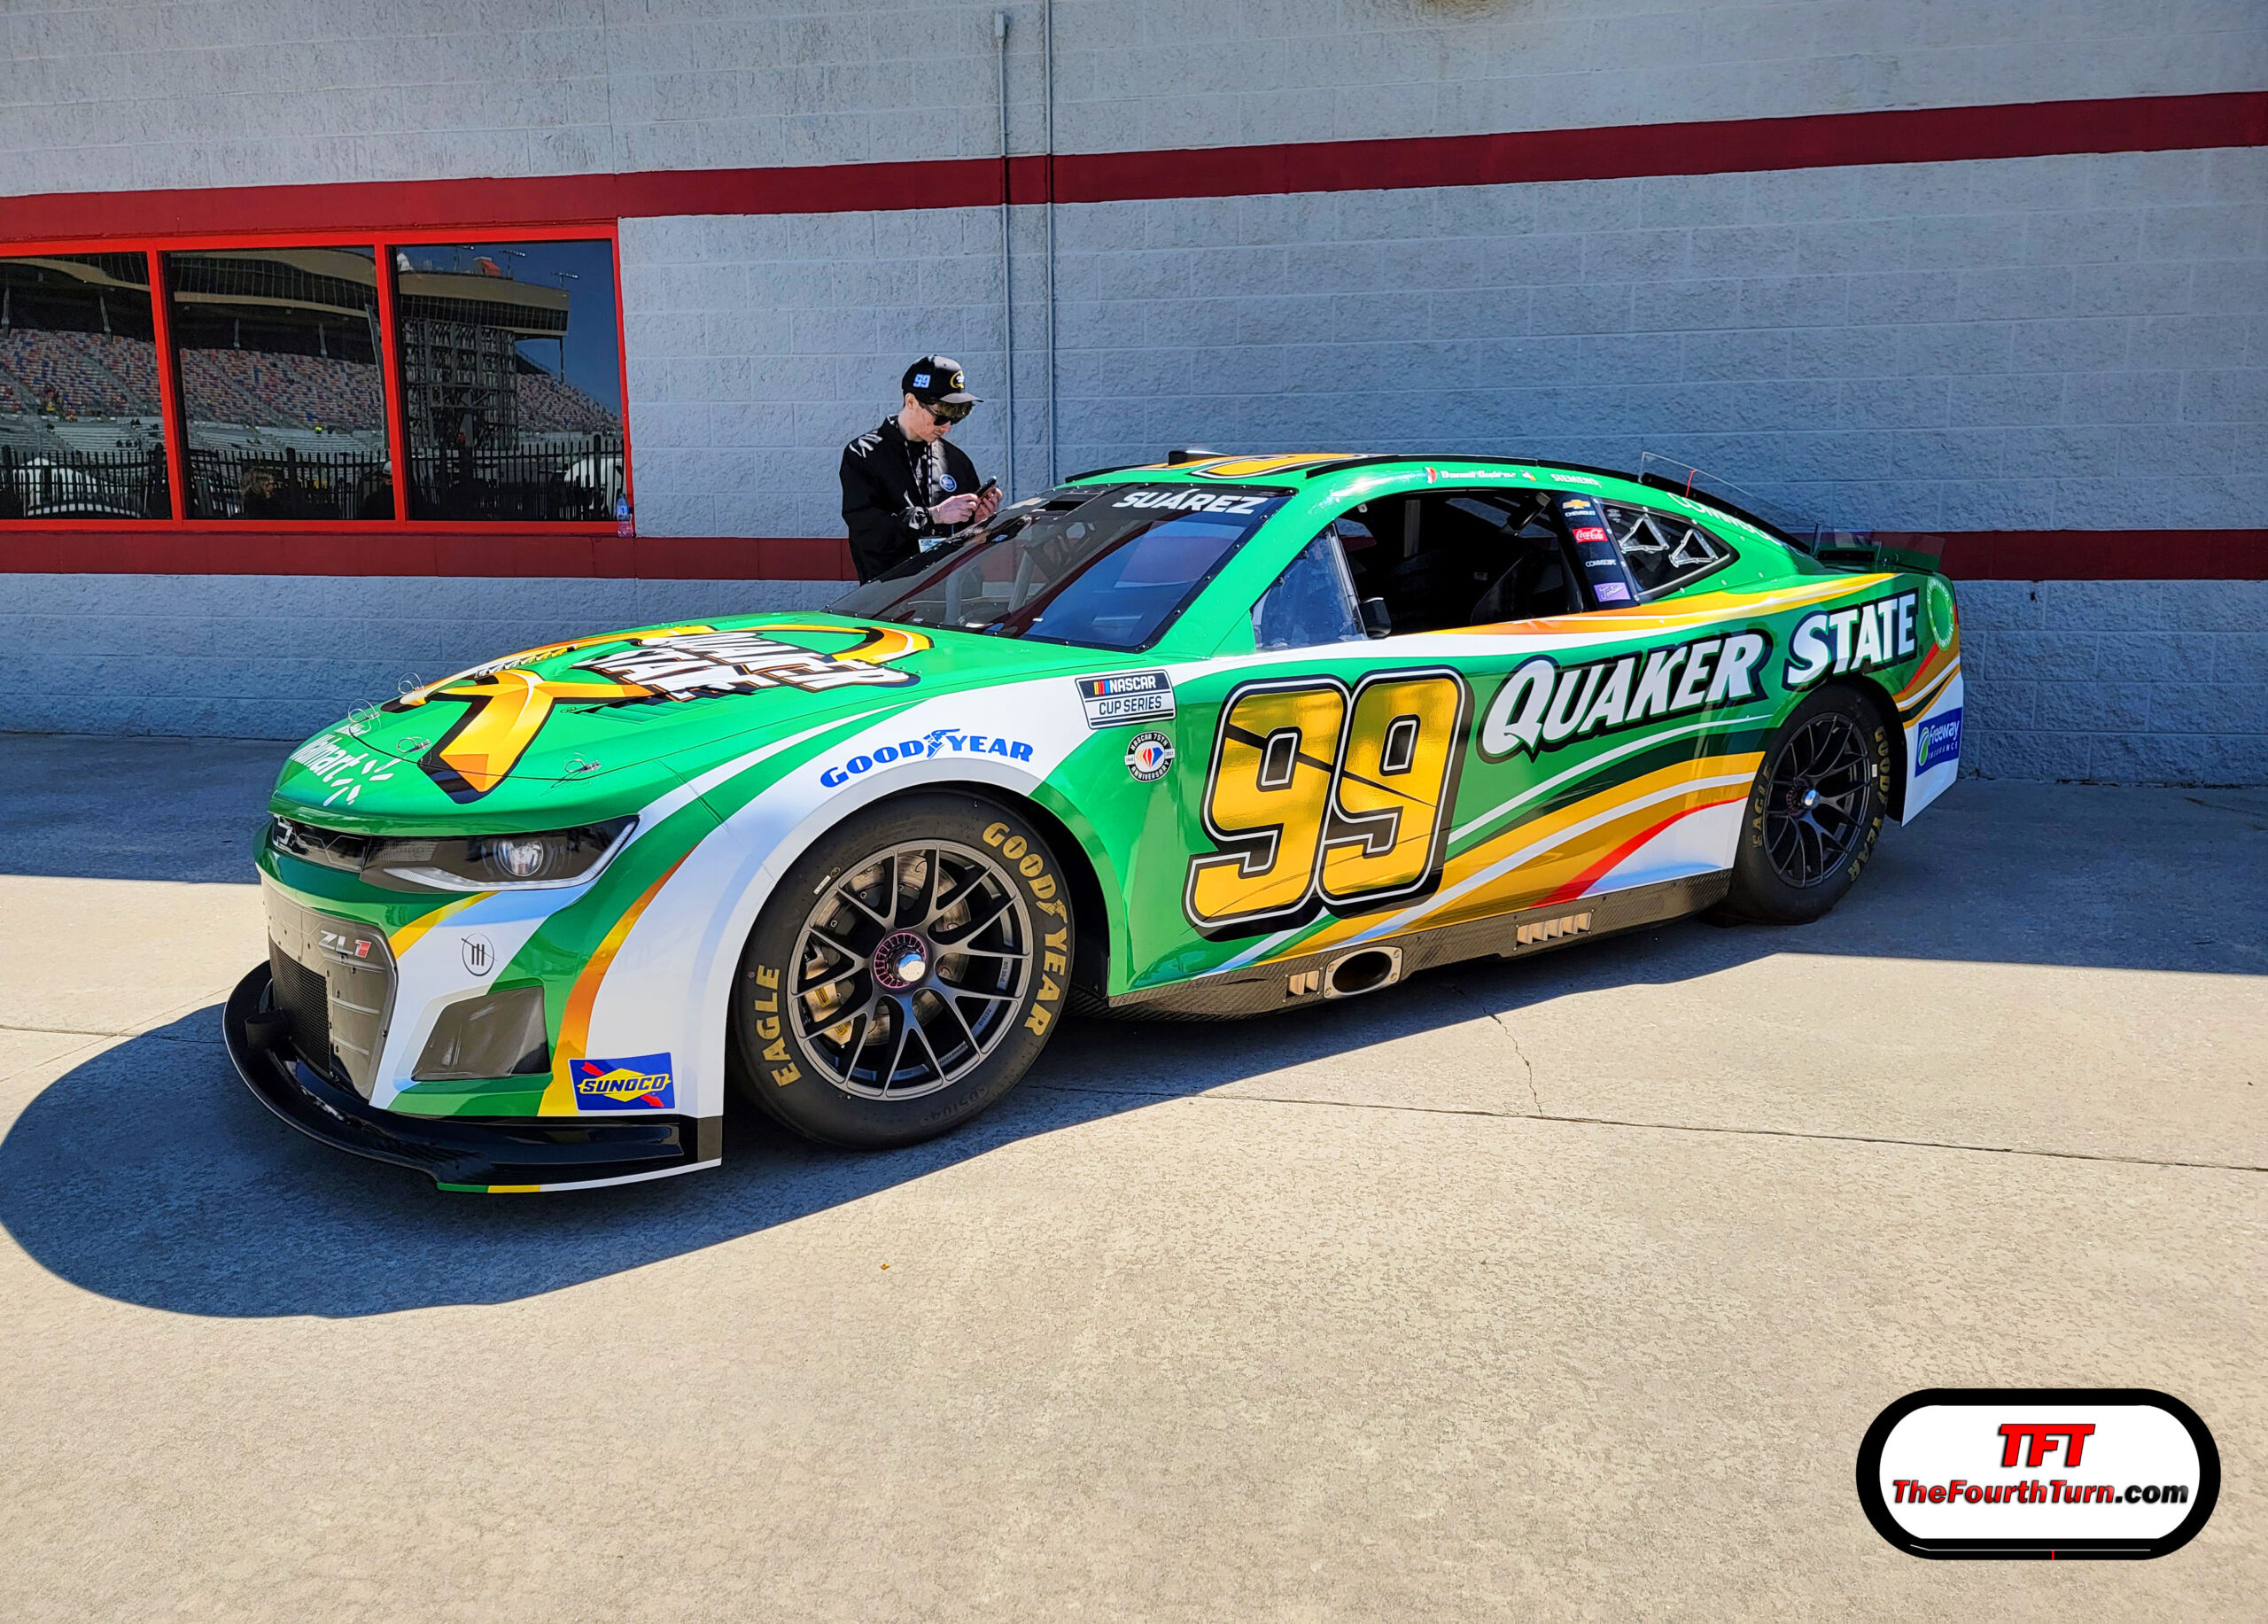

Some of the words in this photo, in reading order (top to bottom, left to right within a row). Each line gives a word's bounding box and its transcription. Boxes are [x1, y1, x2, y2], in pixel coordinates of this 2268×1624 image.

[913, 373, 931, 388] 99
[1112, 488, 1268, 515] SUÁREZ
[1109, 676, 1156, 694] NASCAR
[1481, 633, 1765, 757] QUAKER
[1785, 593, 1917, 686] STATE
[1099, 701, 1121, 716] CUP
[1123, 695, 1162, 712] SERIES
[1130, 734, 1152, 751] NASCAR
[1153, 734, 1169, 747] 75TH
[1929, 720, 1960, 745] Freeway
[819, 728, 1034, 789] GOODYEAR
[1184, 666, 1471, 935] 99
[982, 821, 1068, 1037] GOODYEAR
[318, 929, 372, 959] ZL1
[755, 964, 802, 1088] EAGLE
[582, 1076, 666, 1092] SUNOCO
